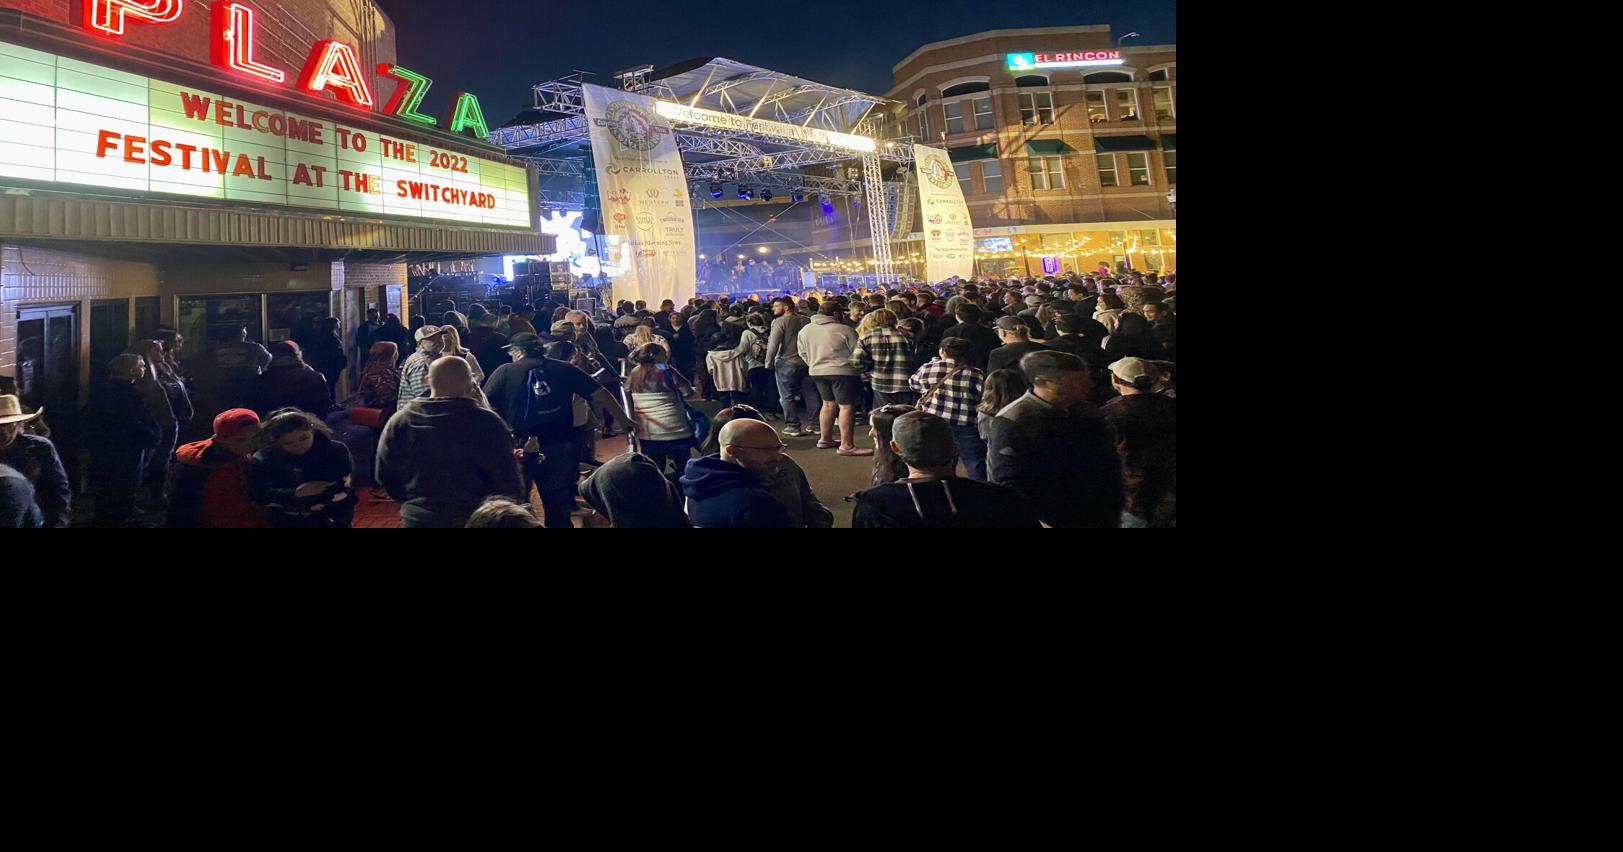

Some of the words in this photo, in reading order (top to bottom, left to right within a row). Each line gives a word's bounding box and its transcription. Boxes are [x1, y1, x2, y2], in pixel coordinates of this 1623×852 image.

[1035, 54, 1051, 63] EL
[1056, 51, 1119, 62] RINCON
[180, 91, 323, 144] WELCOME
[336, 127, 367, 153] TO
[379, 138, 416, 163] THE
[429, 150, 468, 173] 2022
[96, 129, 272, 180] FESTIVAL
[293, 162, 326, 187] AT
[339, 170, 380, 195] THE
[397, 180, 495, 209] SWITCHYARD
[623, 166, 679, 176] CARROLLTON
